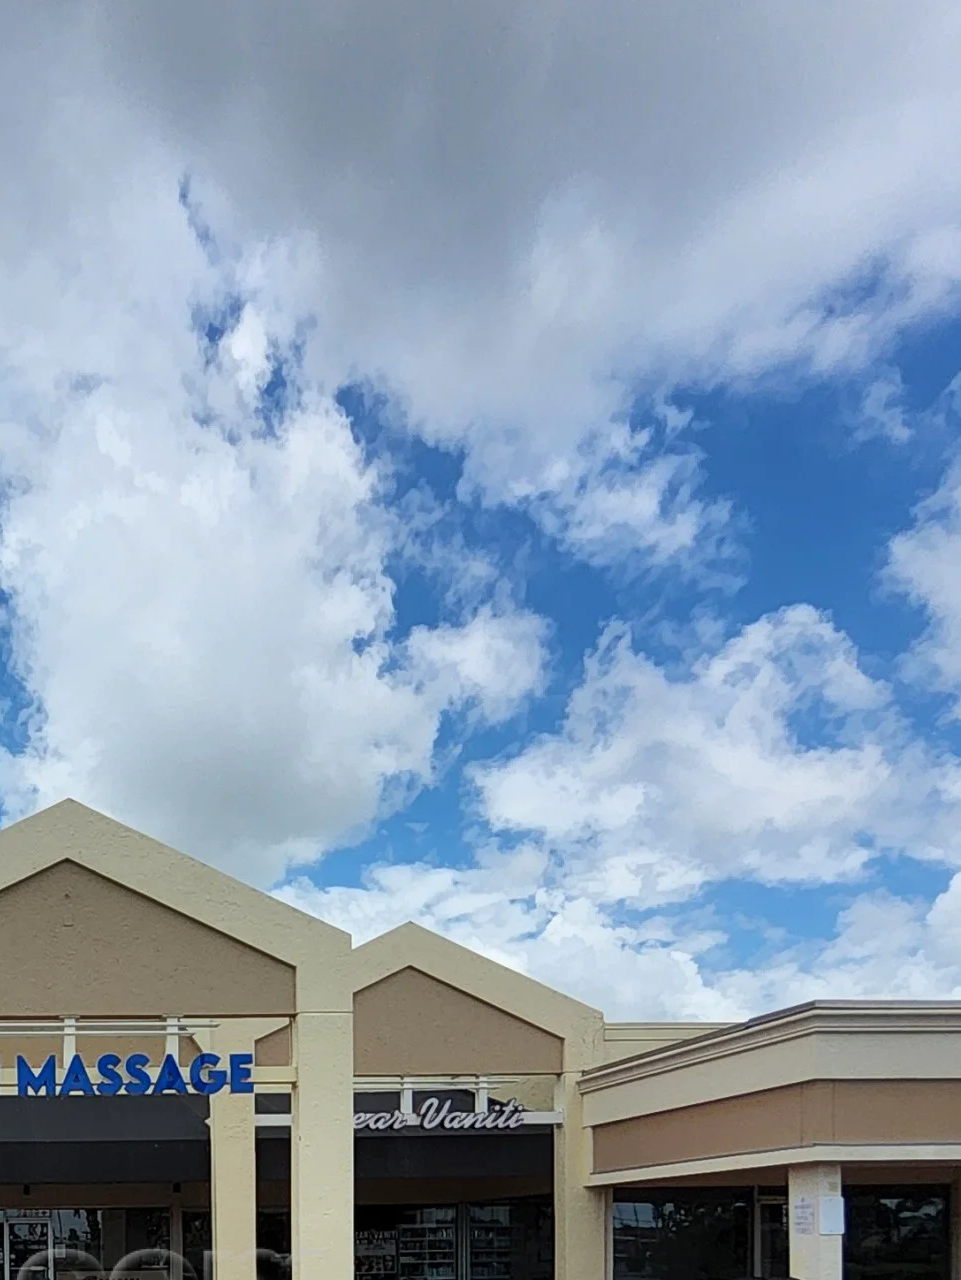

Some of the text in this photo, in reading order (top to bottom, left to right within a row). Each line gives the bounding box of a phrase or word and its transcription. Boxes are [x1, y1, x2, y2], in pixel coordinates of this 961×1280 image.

[16, 1053, 255, 1097] MASSAGE
[354, 1097, 526, 1130] ear Vaniti
